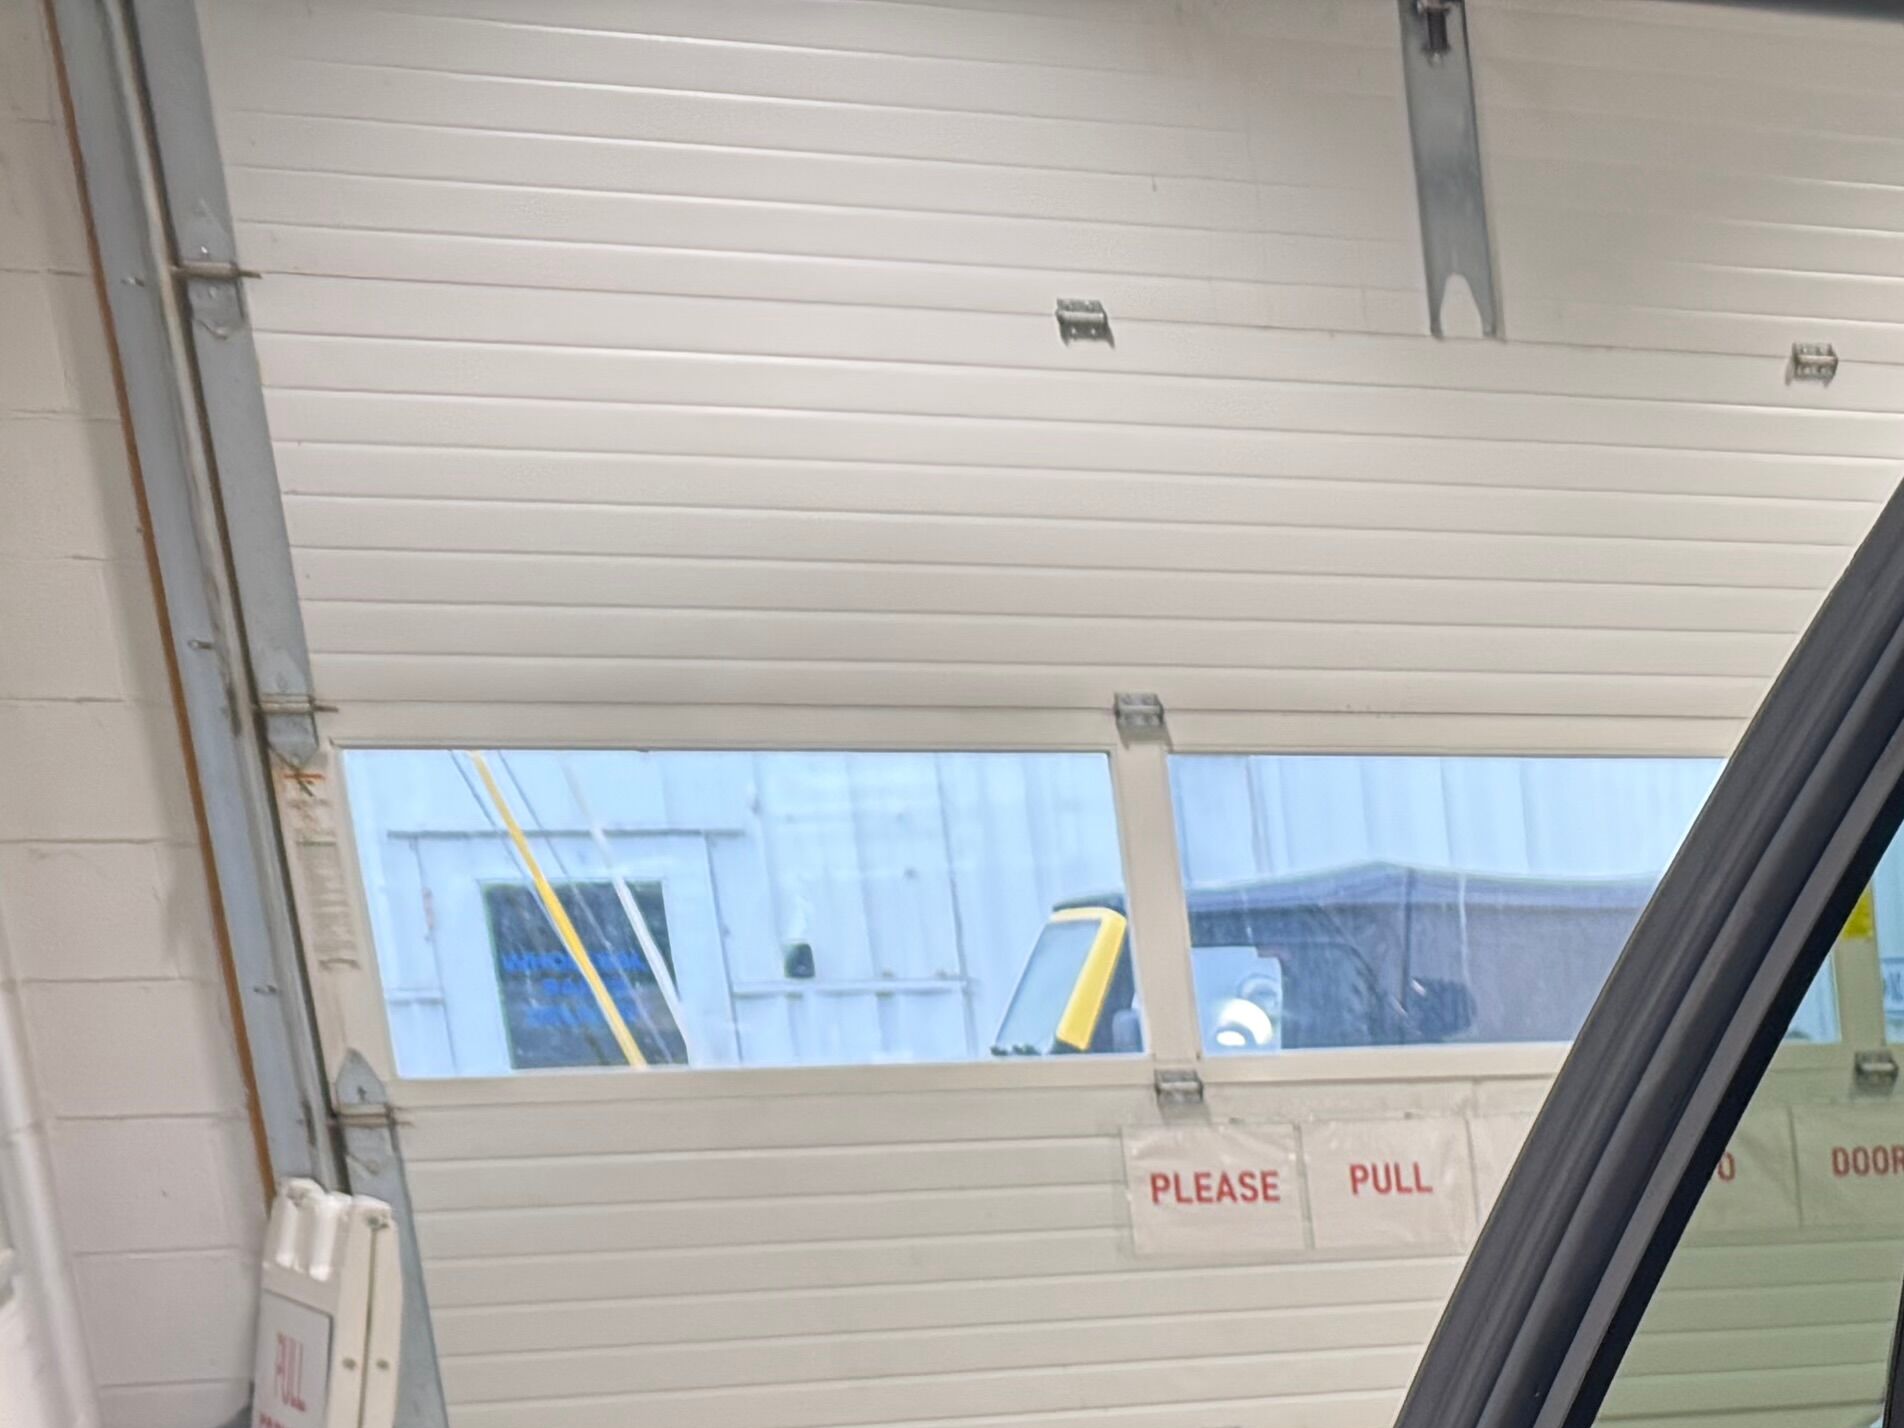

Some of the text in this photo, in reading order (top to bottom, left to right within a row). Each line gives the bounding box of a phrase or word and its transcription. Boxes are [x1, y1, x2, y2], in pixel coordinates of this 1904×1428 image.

[1150, 1170, 1281, 1204] PLEASE
[1349, 1161, 1433, 1195] PULL
[273, 1330, 306, 1412] PULL
